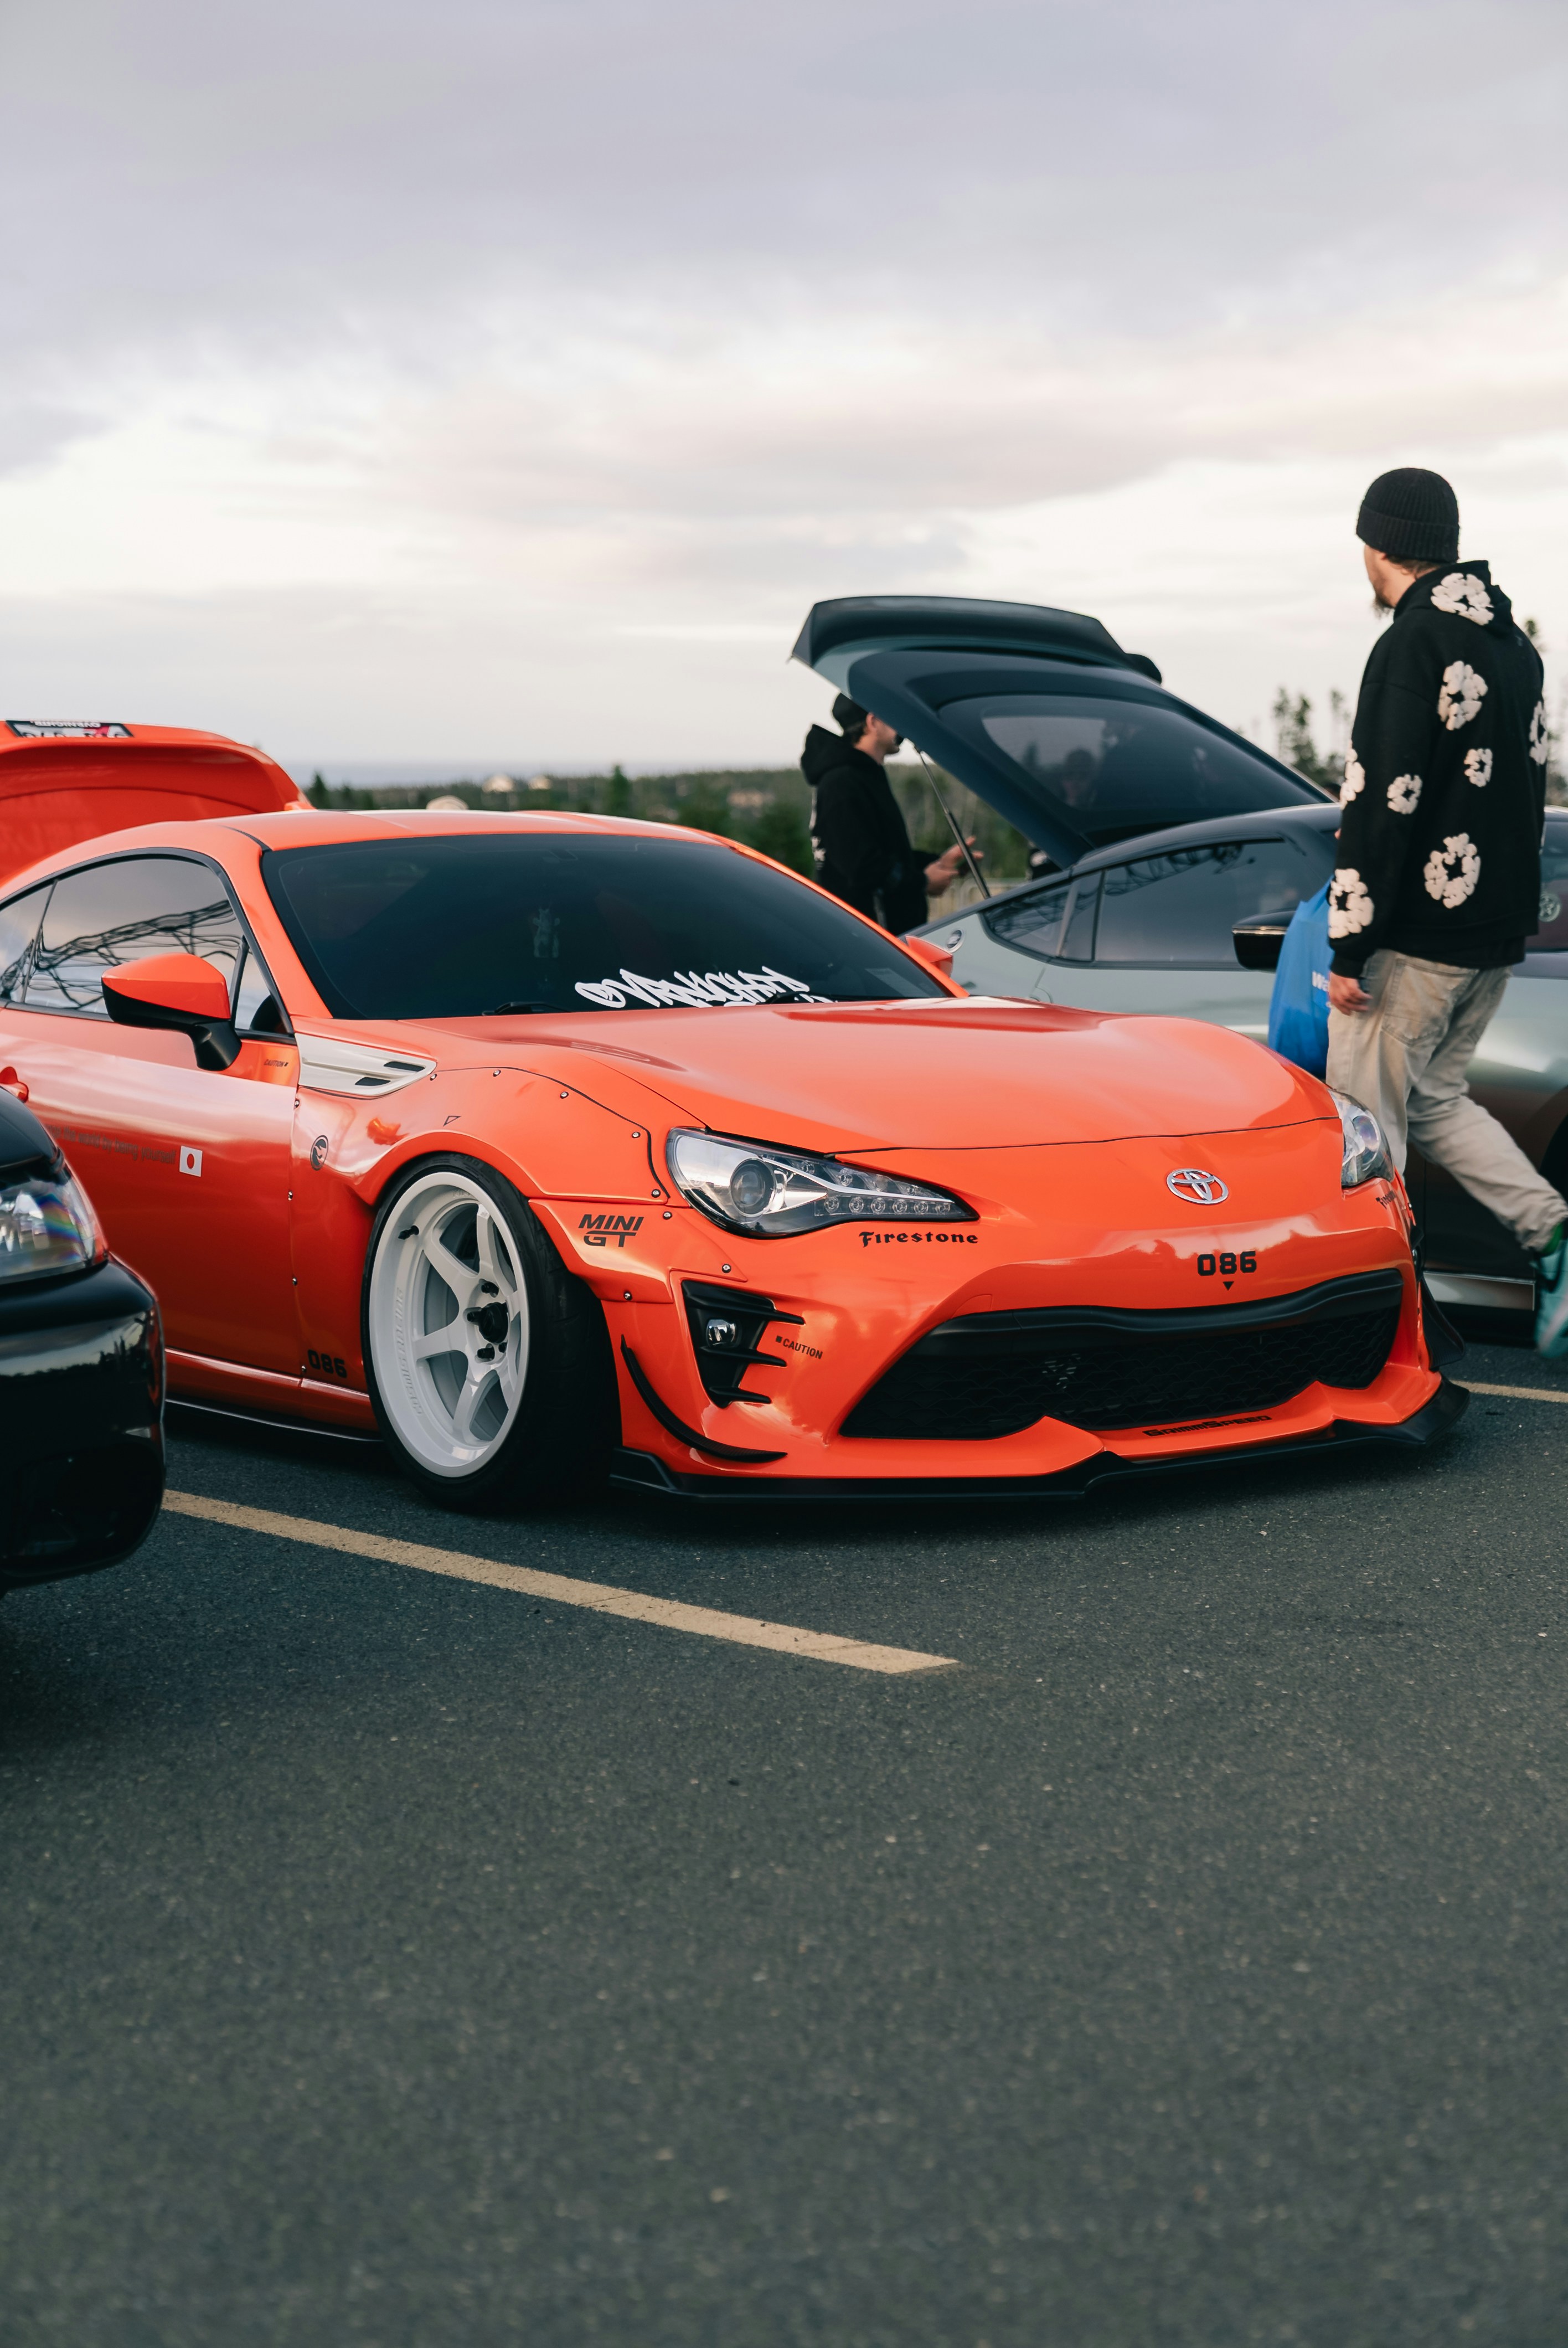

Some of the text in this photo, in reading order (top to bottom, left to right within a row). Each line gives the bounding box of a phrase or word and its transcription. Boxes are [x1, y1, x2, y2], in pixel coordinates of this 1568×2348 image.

[577, 1214, 645, 1231] MINI
[583, 1230, 637, 1248] GT
[859, 1231, 979, 1248] Firestone
[1196, 1250, 1257, 1277] 086
[782, 1338, 823, 1360] CAUTION
[307, 1349, 348, 1378] 086
